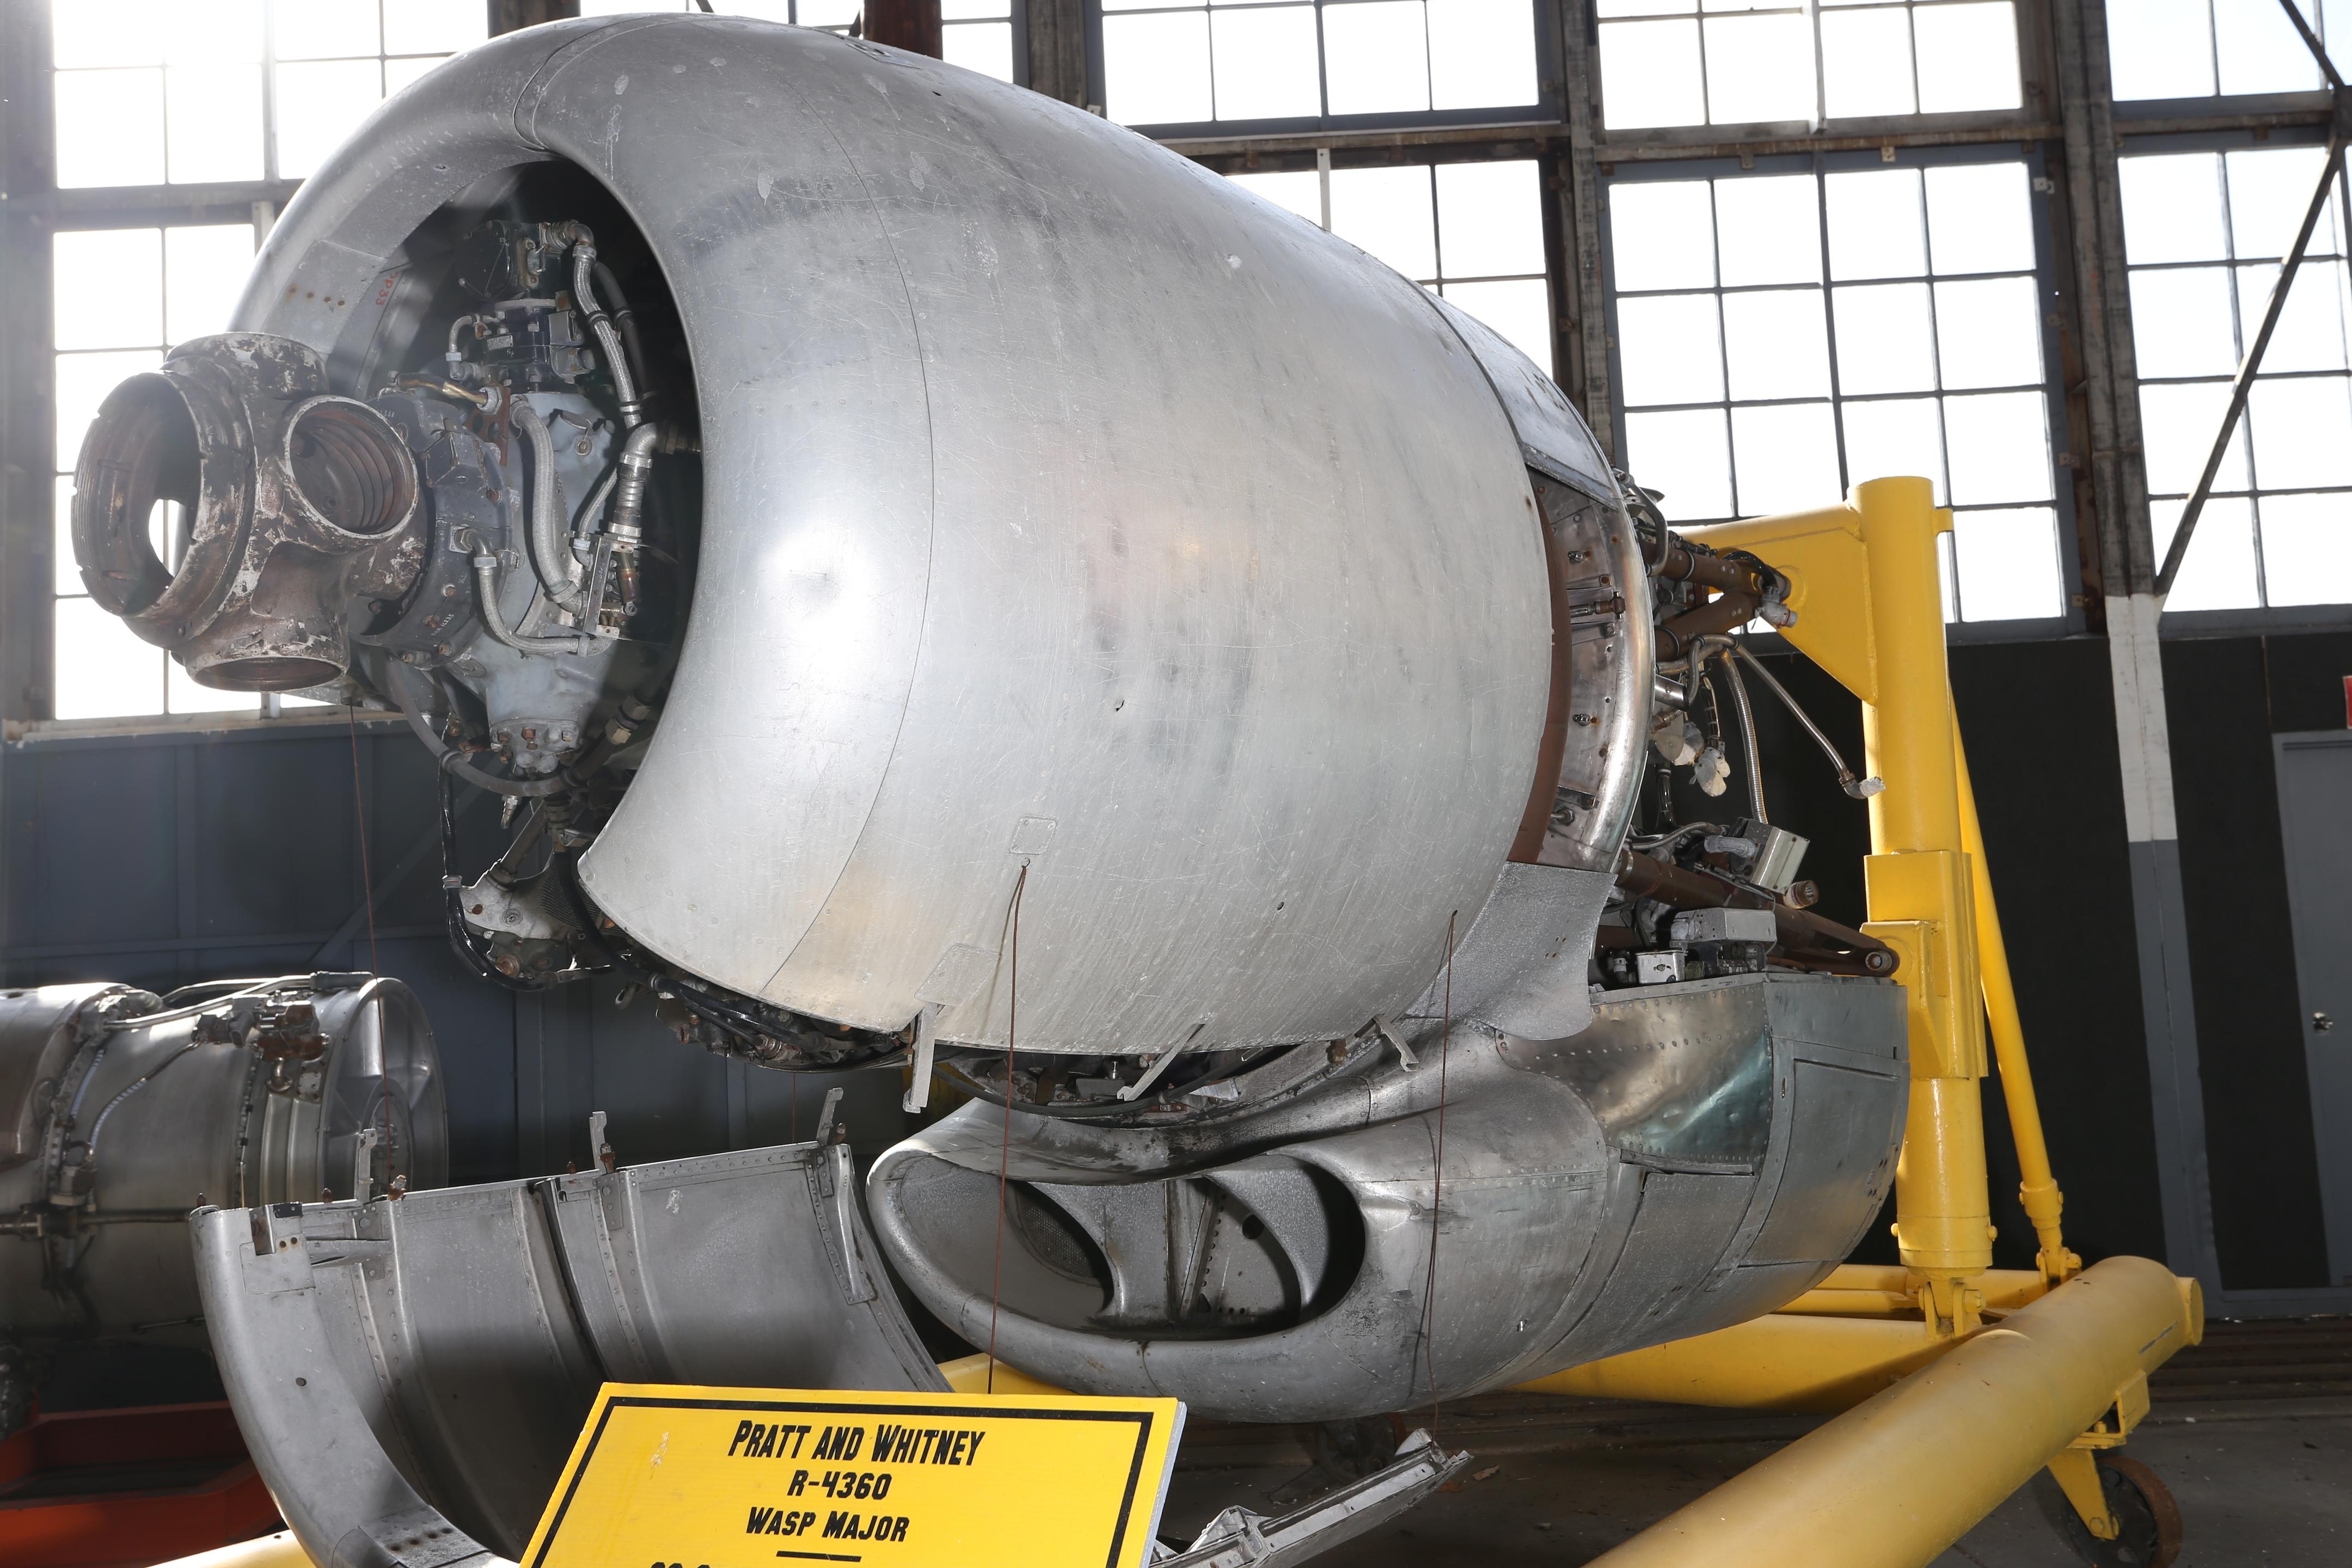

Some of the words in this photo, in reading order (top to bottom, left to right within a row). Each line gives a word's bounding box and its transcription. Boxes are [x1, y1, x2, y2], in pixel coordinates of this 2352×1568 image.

[728, 1420, 812, 1459] PRATT
[811, 1426, 865, 1461] AND
[871, 1424, 985, 1466] WHITNEY
[787, 1469, 892, 1500] R-4360
[746, 1506, 816, 1536] WASP
[822, 1511, 910, 1542] MAJOR
